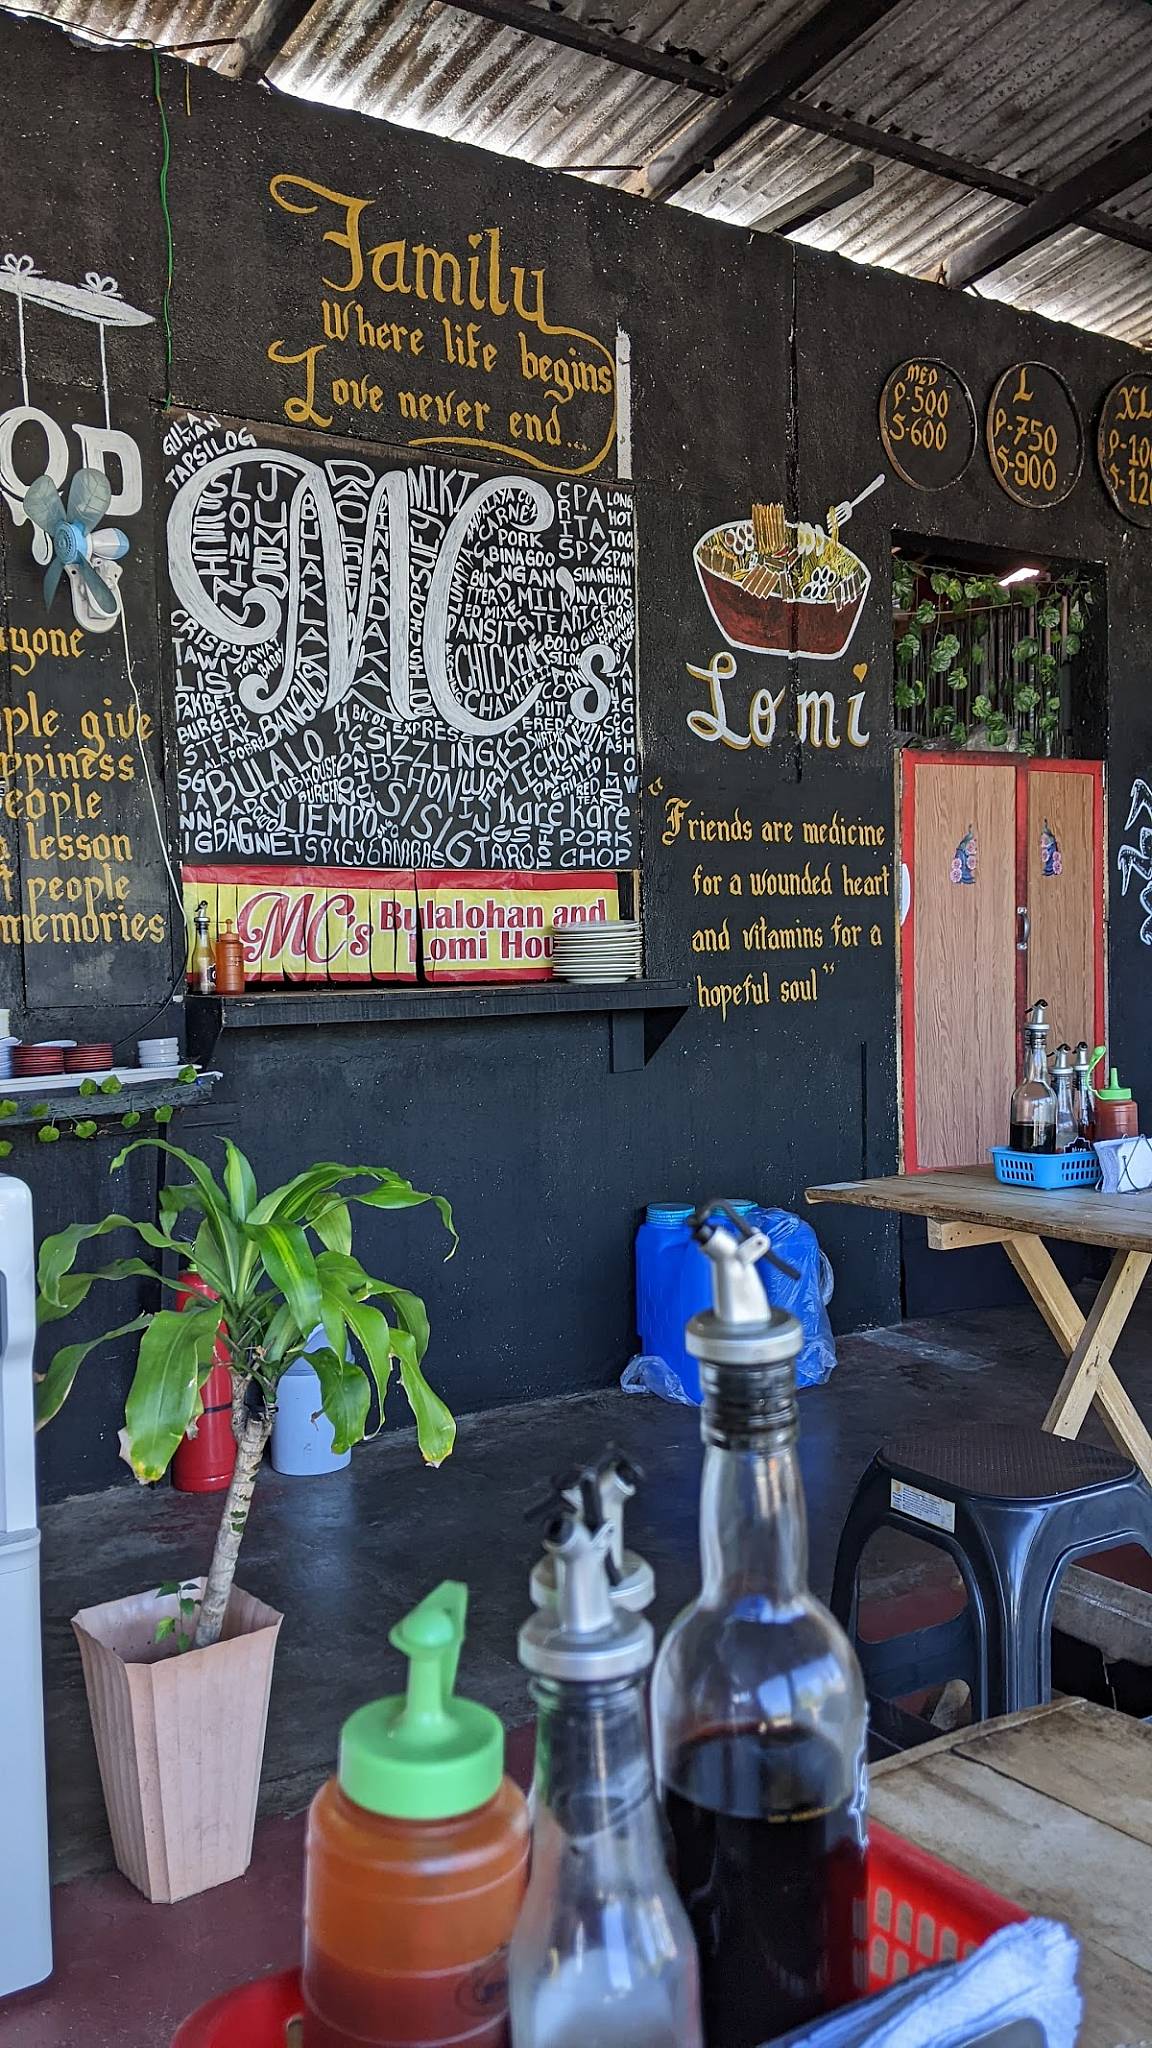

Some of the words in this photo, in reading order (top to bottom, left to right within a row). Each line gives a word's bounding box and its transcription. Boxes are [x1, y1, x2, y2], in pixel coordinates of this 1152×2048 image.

[269, 173, 549, 335] Family
[321, 299, 424, 356] Where
[441, 316, 498, 372] life
[518, 331, 613, 404] begins
[267, 339, 384, 427] Love
[398, 389, 491, 432] never
[904, 364, 938, 386] MED
[1012, 367, 1034, 404] L
[1115, 385, 1152, 420] XL
[165, 427, 257, 490] TAPSILOG
[1109, 429, 1152, 469] P-10
[1109, 463, 1152, 505] S-12
[498, 528, 544, 549] PORK
[573, 566, 631, 587] SHANGHAI
[601, 550, 635, 568] SPAM
[576, 585, 633, 608] NACHOS
[170, 609, 246, 664] CRISPY
[446, 613, 516, 645] PANSIT
[530, 611, 573, 635] TEA
[455, 643, 541, 695] CHICKEN
[175, 691, 236, 722] PAKBET
[352, 703, 387, 729] BICOL
[686, 651, 870, 751] Lomi
[80, 697, 153, 756] give
[176, 703, 248, 745] BURGER
[183, 720, 259, 766] STEAK
[392, 719, 474, 744] EXPRESS
[365, 727, 495, 772] SIZZLING
[205, 728, 324, 818] BULALO
[275, 801, 378, 839] LIEMPO
[499, 788, 565, 827] kare
[569, 794, 631, 831] kare
[26, 821, 133, 861] lesson
[213, 817, 305, 857] BAGNET
[560, 828, 633, 848] PORK
[761, 821, 794, 844] are
[802, 811, 886, 847] medicine
[304, 836, 365, 867] SPICY
[560, 848, 632, 868] CHOP
[27, 863, 130, 918] people
[691, 864, 723, 897] for
[729, 877, 743, 897] a
[749, 862, 833, 897] wounded
[842, 864, 889, 897] heart
[0, 904, 166, 944] memories
[380, 898, 544, 933] Bulalohan
[552, 898, 607, 928] and
[691, 917, 730, 952] and
[742, 915, 824, 950] vitamins
[830, 914, 862, 948] for
[870, 923, 883, 947] a
[409, 931, 488, 964] Lomi
[696, 973, 770, 1022] hopeful
